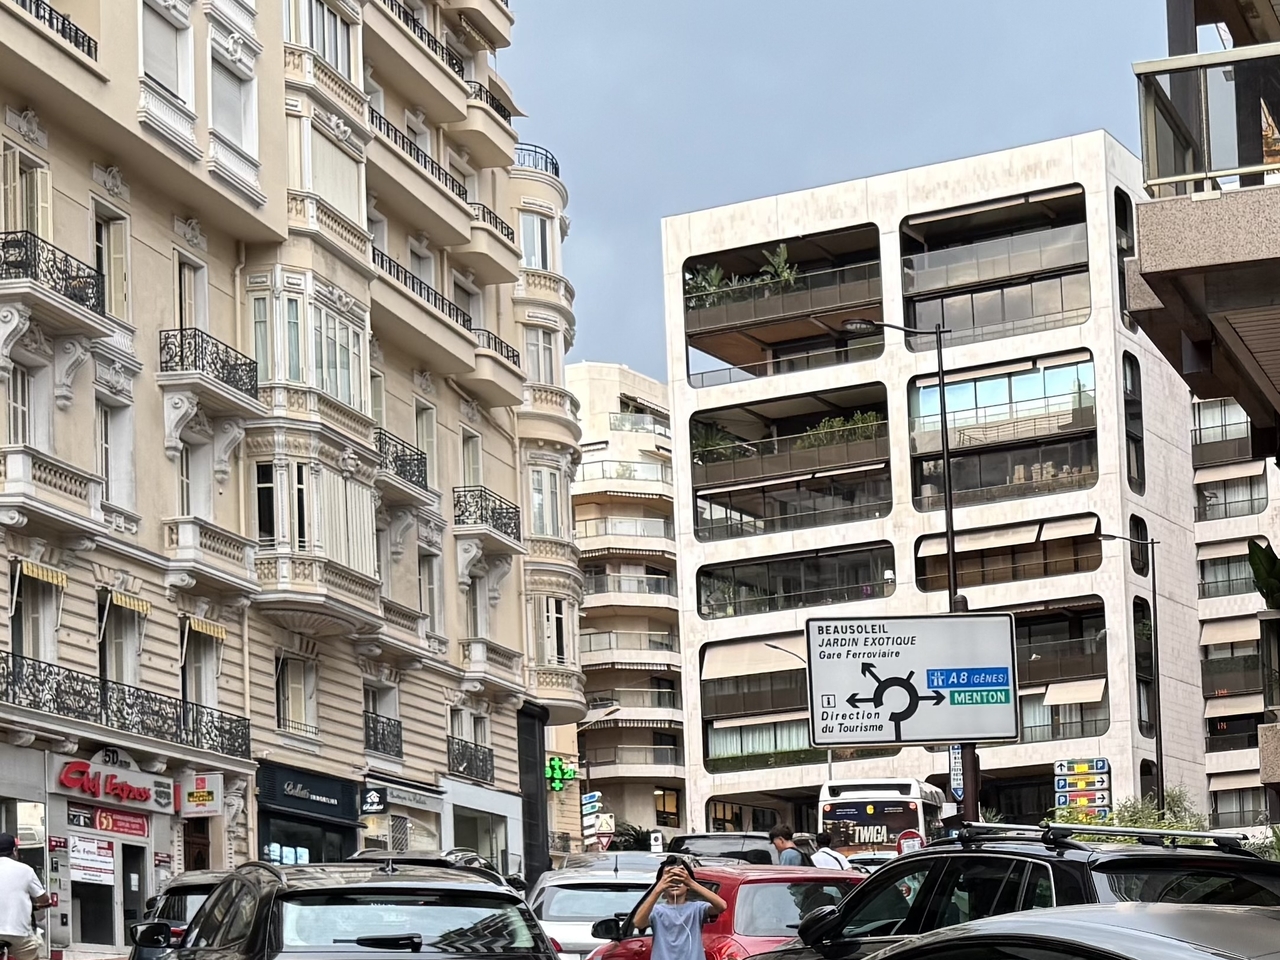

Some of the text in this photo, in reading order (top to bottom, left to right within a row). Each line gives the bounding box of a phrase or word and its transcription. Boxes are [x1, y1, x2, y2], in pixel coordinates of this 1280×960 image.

[817, 624, 888, 635] BEAUSOLEIL
[818, 635, 917, 648] JARDIN EXOTIQUE
[818, 648, 901, 660] Gare Ferroviaire
[970, 673, 1008, 685] (GÊNES)
[954, 691, 1006, 704] MENTON
[821, 710, 880, 721] Direction
[821, 722, 884, 733] du Tourisme
[103, 747, 119, 765] 50
[854, 825, 888, 843] TWIGA
